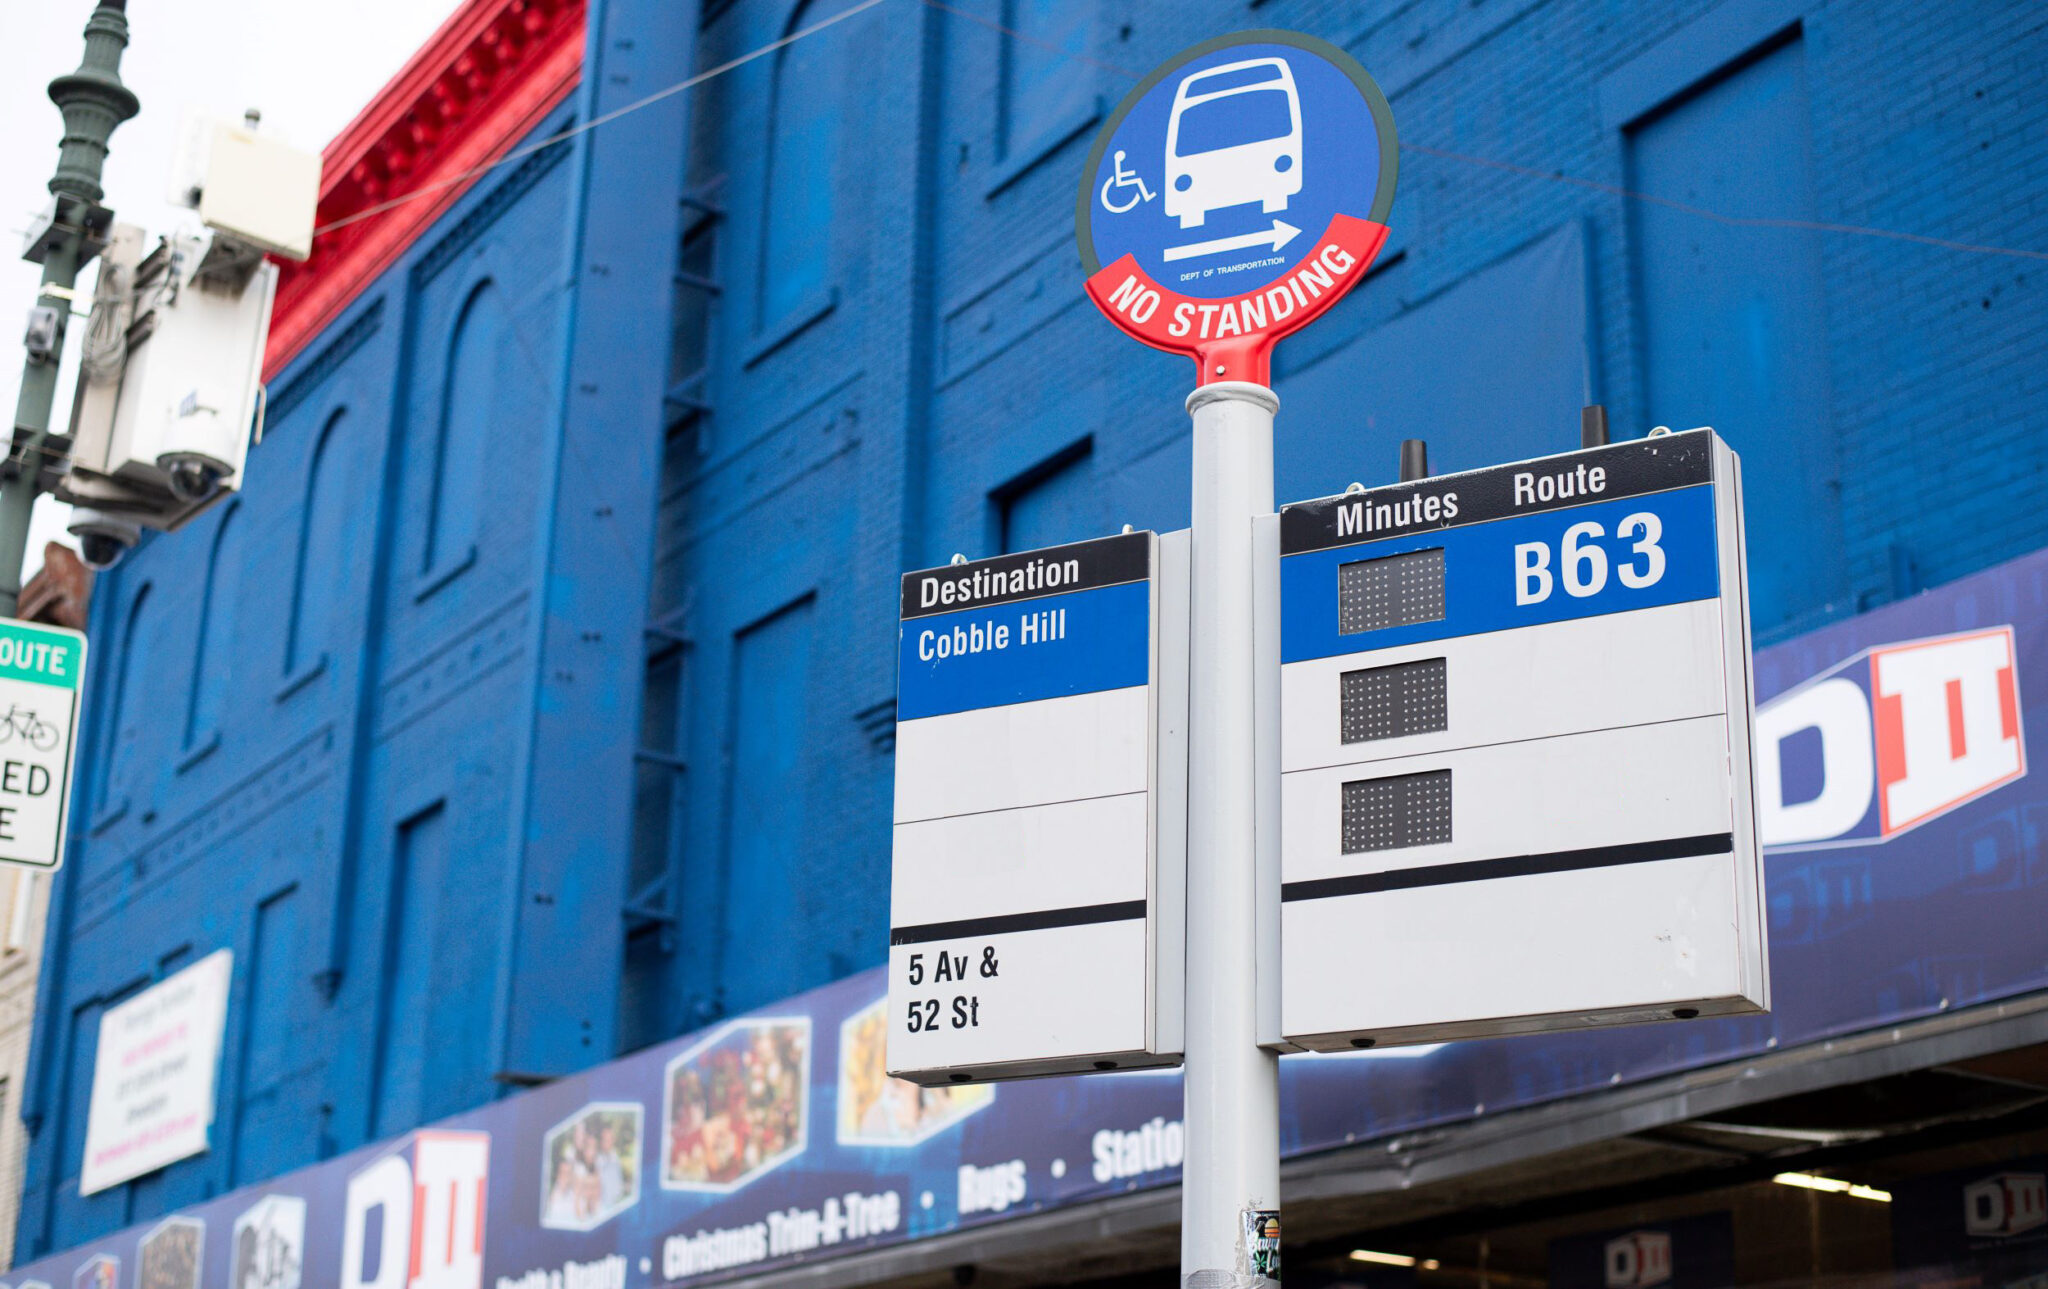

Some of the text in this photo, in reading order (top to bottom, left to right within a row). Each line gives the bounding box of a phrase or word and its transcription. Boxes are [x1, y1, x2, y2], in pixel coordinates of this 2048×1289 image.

[1108, 244, 1356, 339] NO STANDING
[1181, 256, 1285, 281] DEPT OF TRANSPORTATION
[1337, 464, 1607, 537] Minutes Route
[921, 559, 1079, 608] Destination
[1515, 512, 1666, 606] B63
[919, 609, 1066, 661] Cobble Hill
[909, 946, 999, 985] 5 Av &
[907, 995, 979, 1033] 52 St
[663, 1222, 768, 1280] Christmas
[767, 1190, 900, 1257] Trim-A-Tree
[957, 1158, 1026, 1214] Rugs
